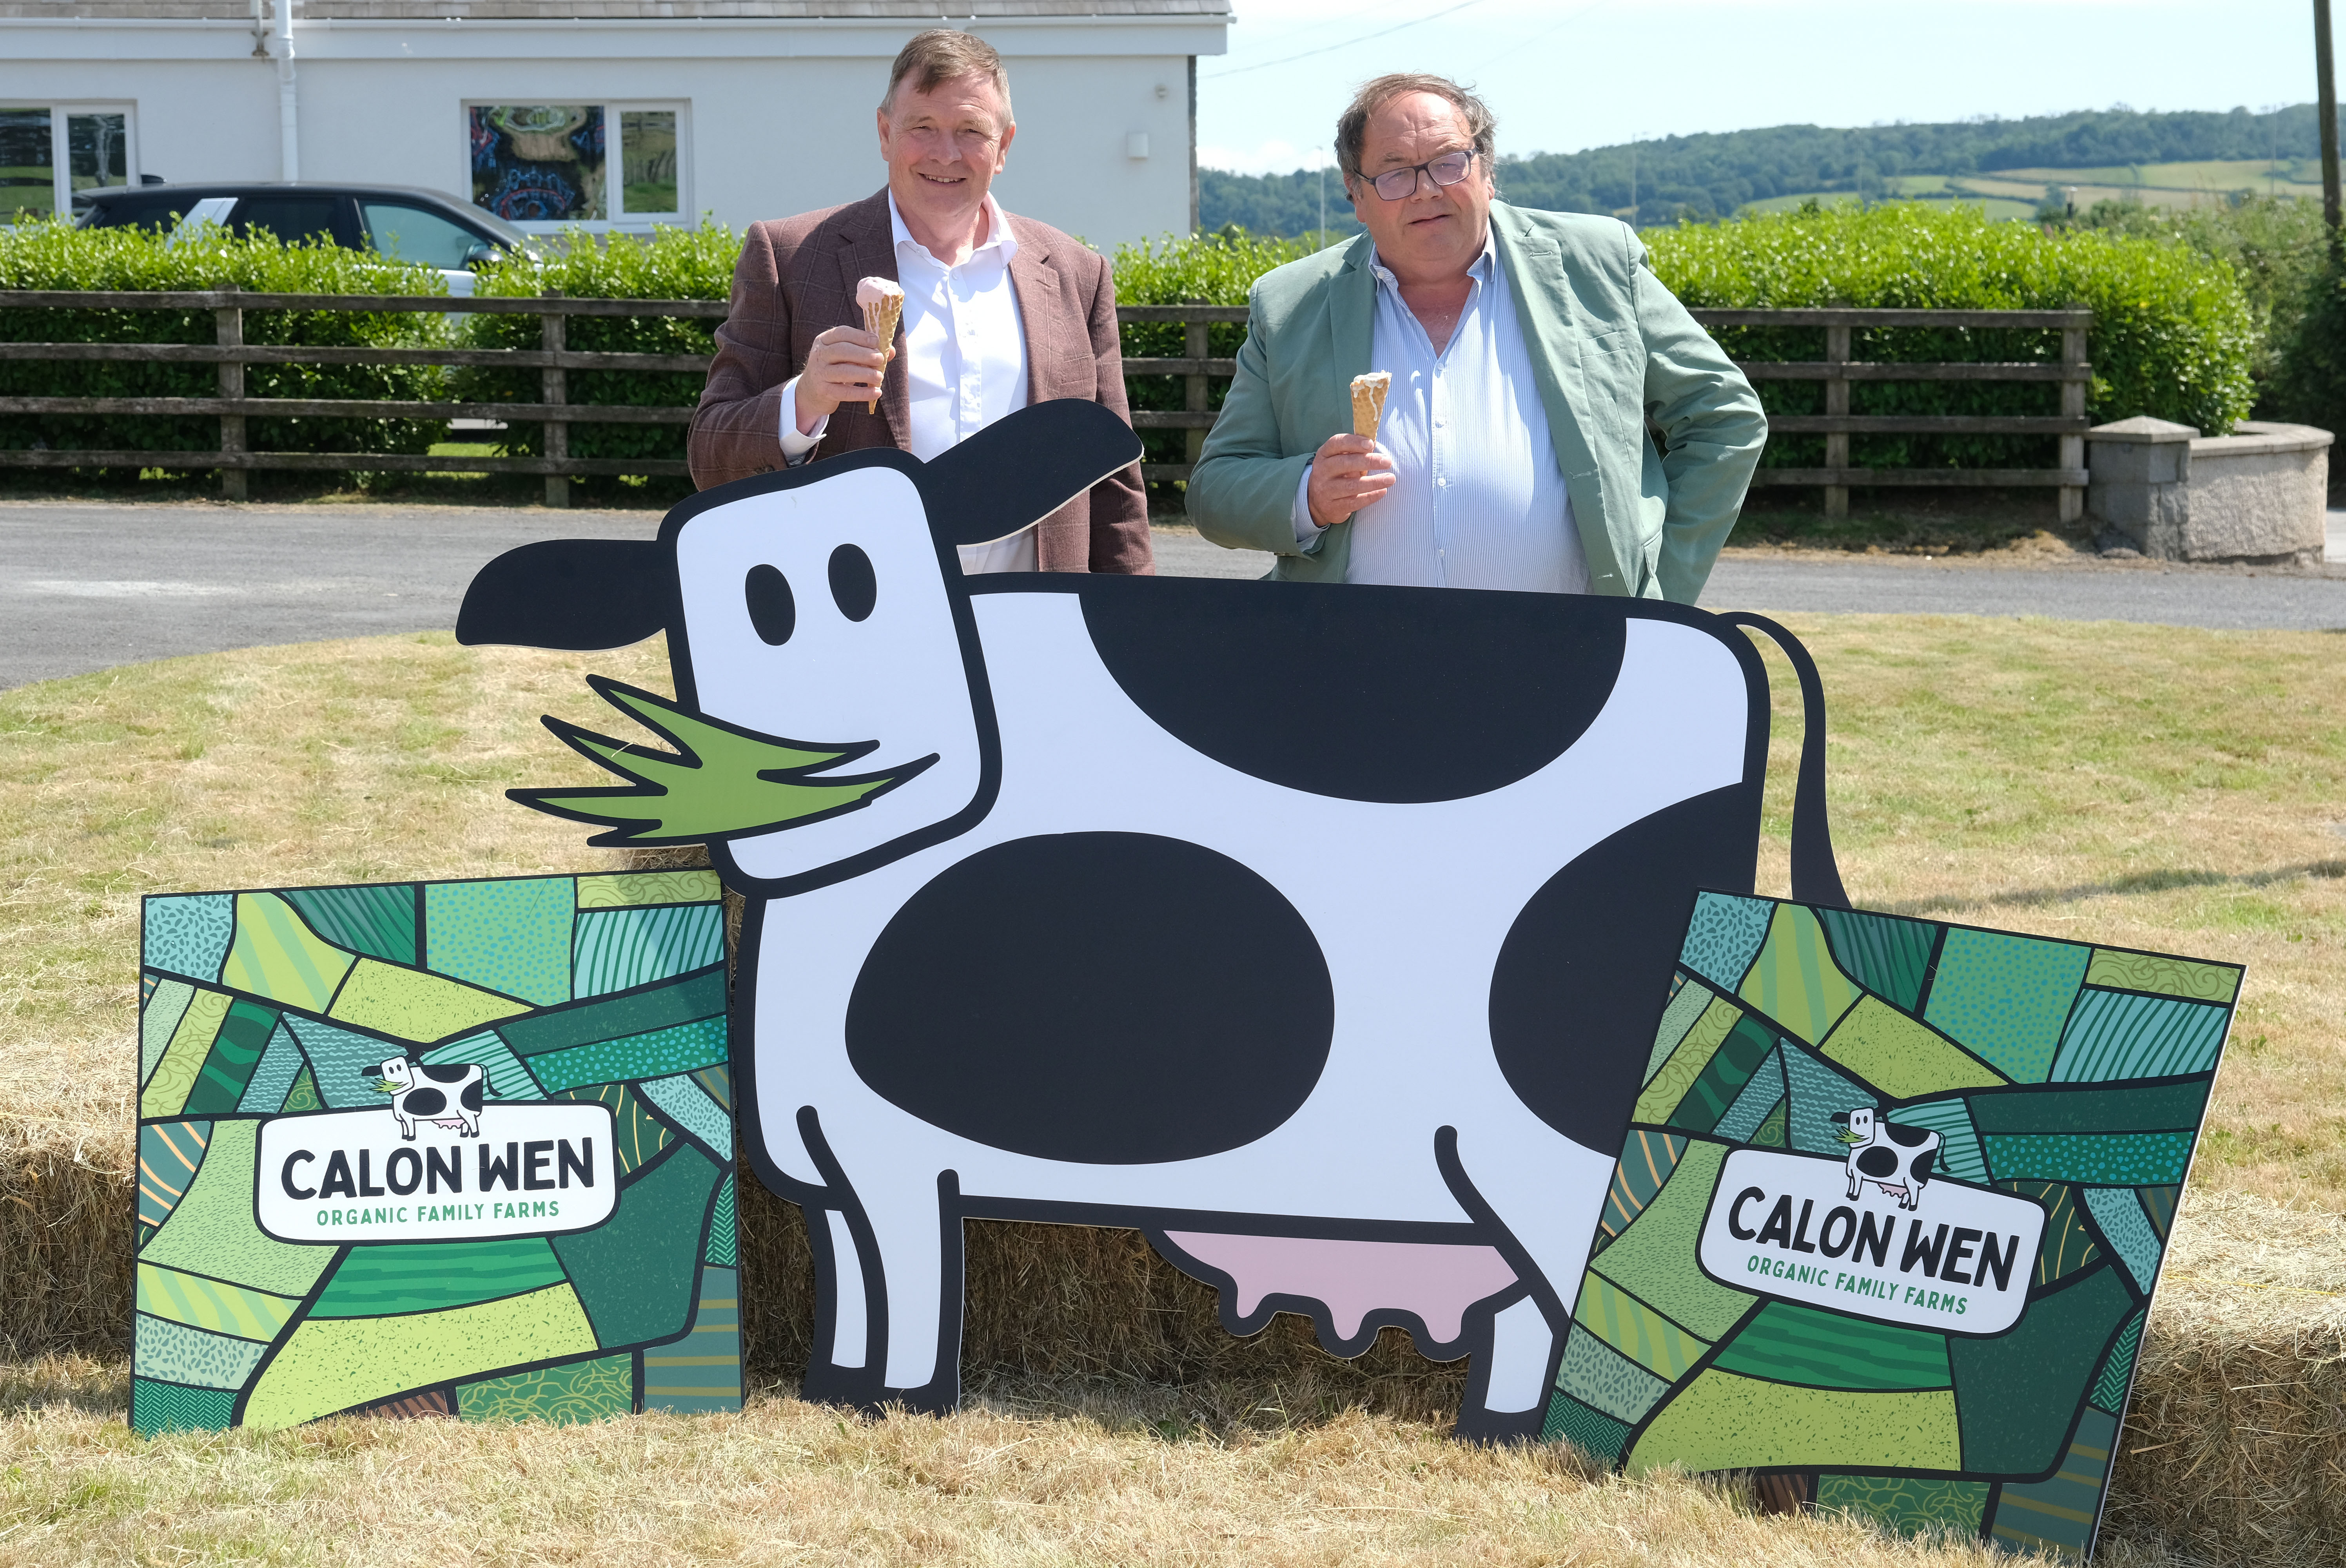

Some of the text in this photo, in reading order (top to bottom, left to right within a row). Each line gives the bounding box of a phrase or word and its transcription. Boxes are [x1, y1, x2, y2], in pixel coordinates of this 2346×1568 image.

[281, 1137, 594, 1200] CALON WEN
[317, 1201, 559, 1226] ORGANIC FAMILY FARMS
[1728, 1186, 2020, 1292] CALON WEN
[1747, 1255, 1968, 1315] ORGANIC FAMILY FARMS
